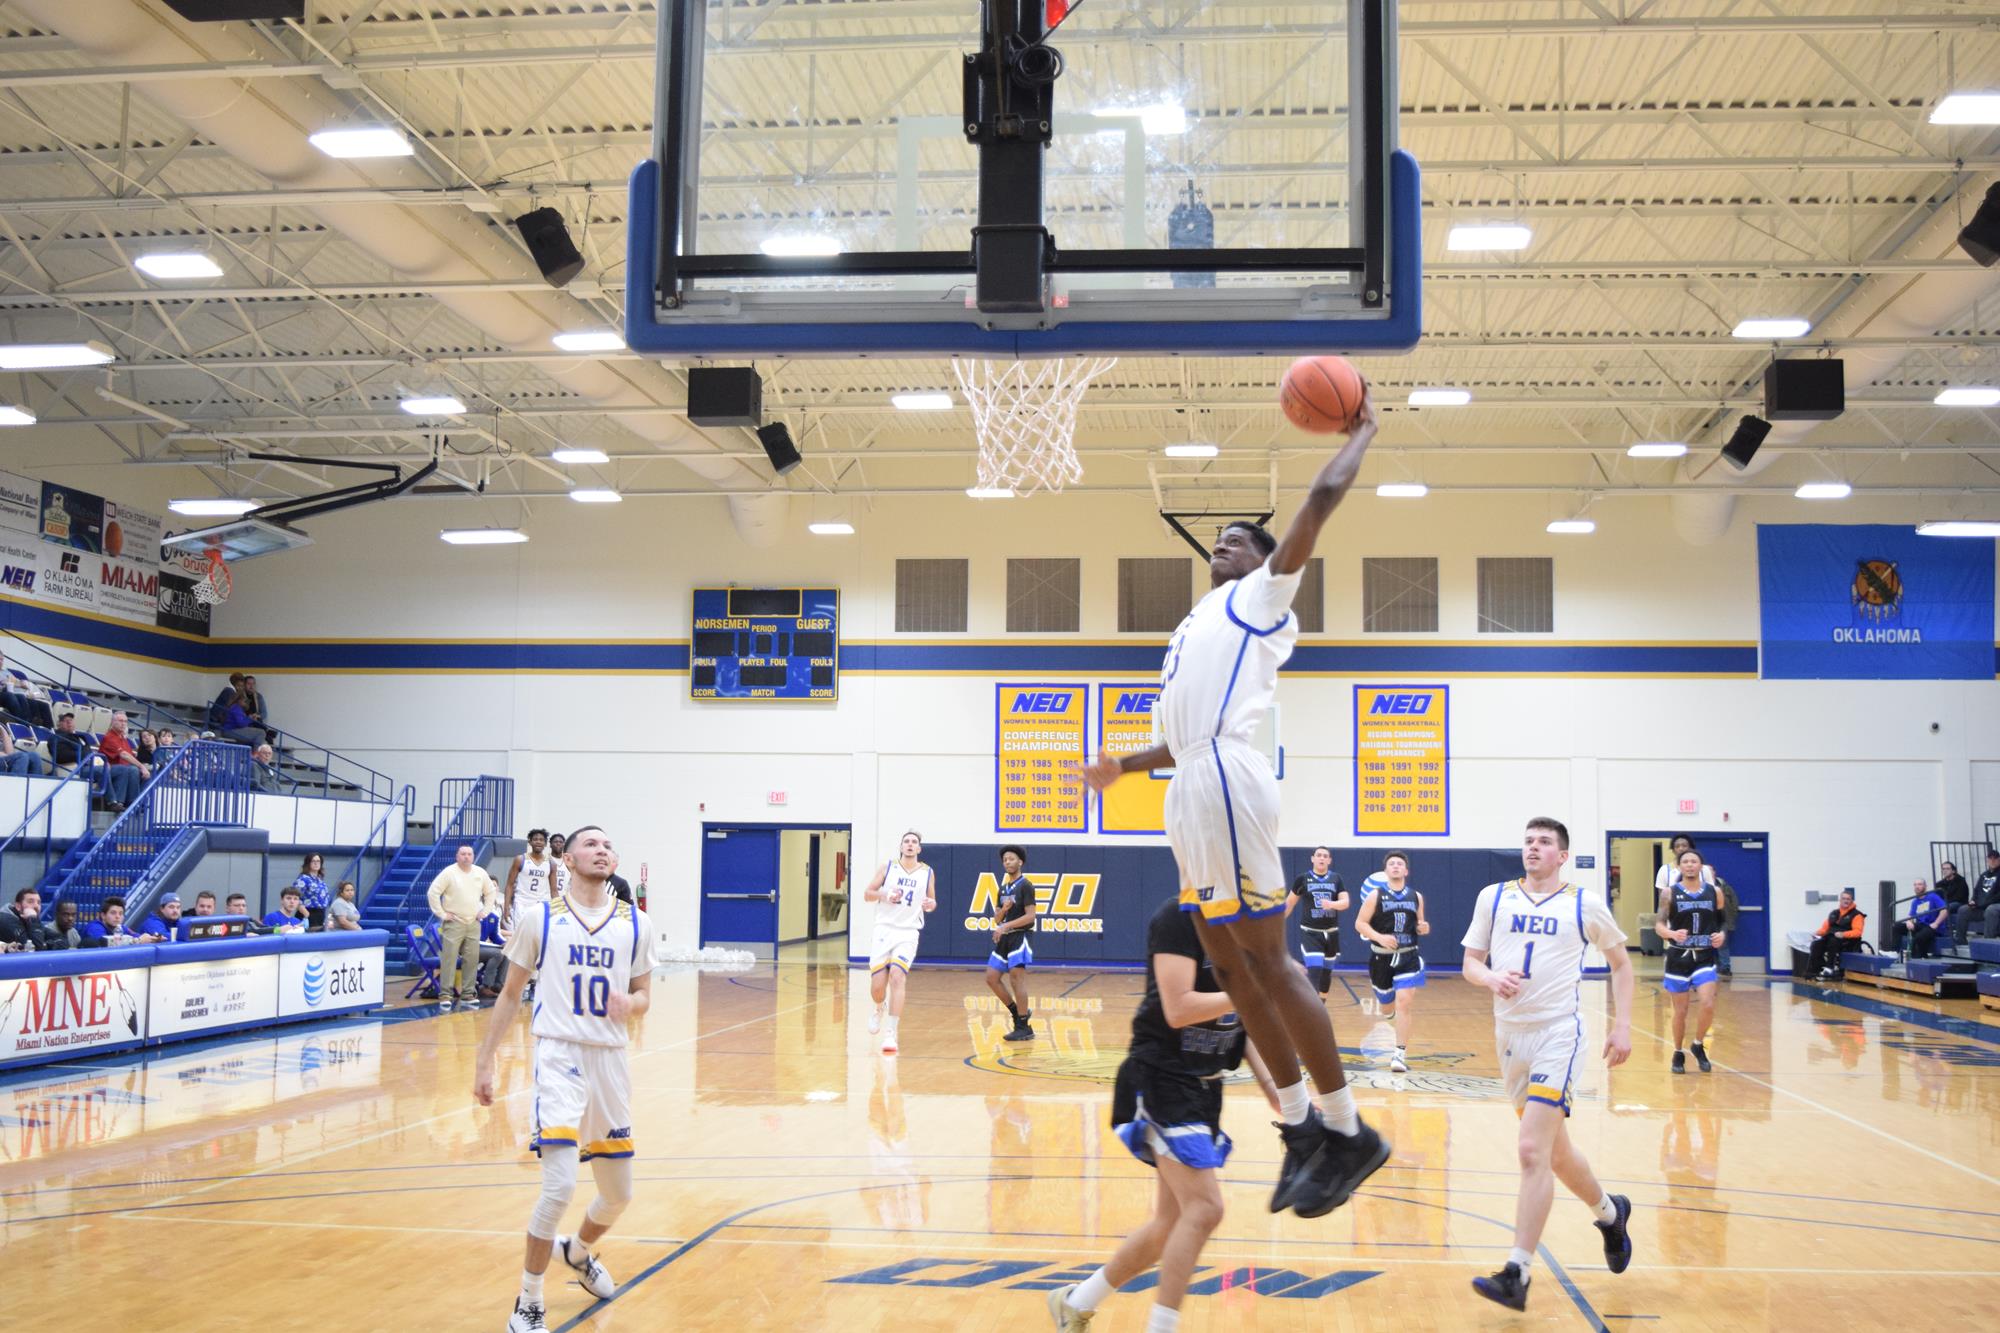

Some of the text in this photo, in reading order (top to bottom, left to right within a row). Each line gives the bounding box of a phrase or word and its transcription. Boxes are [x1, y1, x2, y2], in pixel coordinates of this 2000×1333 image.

[0, 565, 36, 589] NEO
[101, 562, 158, 597] MIAMI
[44, 583, 63, 597] FARM
[65, 587, 93, 602] BUREAU
[695, 619, 832, 630] NORSEMEN GUEST
[751, 625, 777, 633] PERIOD
[1833, 627, 1921, 644] OKLAHOMA
[693, 658, 833, 666] FOULS PLAYER FOUL FOULS
[693, 689, 833, 697] SCORE MATCH SCORE
[1010, 691, 1074, 714] NEO
[1369, 693, 1434, 715] NEO
[1004, 731, 1079, 741] CONFERENCE
[1004, 742, 1079, 752] CHAMPIONS
[1005, 759, 1026, 768] 1979
[1030, 759, 1052, 768] 1985
[1005, 773, 1026, 781] 1987
[1030, 773, 1052, 781] 1988
[1005, 787, 1026, 795] 1990
[1030, 787, 1052, 795] 1991
[1005, 800, 1026, 809] 2000
[1030, 800, 1052, 809] 2001
[1005, 814, 1078, 823] 2007 2014 2015
[528, 869, 545, 877] NEO
[530, 878, 539, 891] 2
[896, 877, 917, 888] NEO
[968, 872, 1102, 915] NEO
[1041, 918, 1103, 932] NORSE
[1510, 914, 1558, 936] NEO
[568, 944, 615, 969] NEO
[1519, 941, 1535, 979] 1
[330, 960, 365, 996] at&t
[571, 973, 610, 1017] 10
[19, 973, 112, 1035] MNE
[15, 1029, 111, 1051] Miami Nation Enterprises
